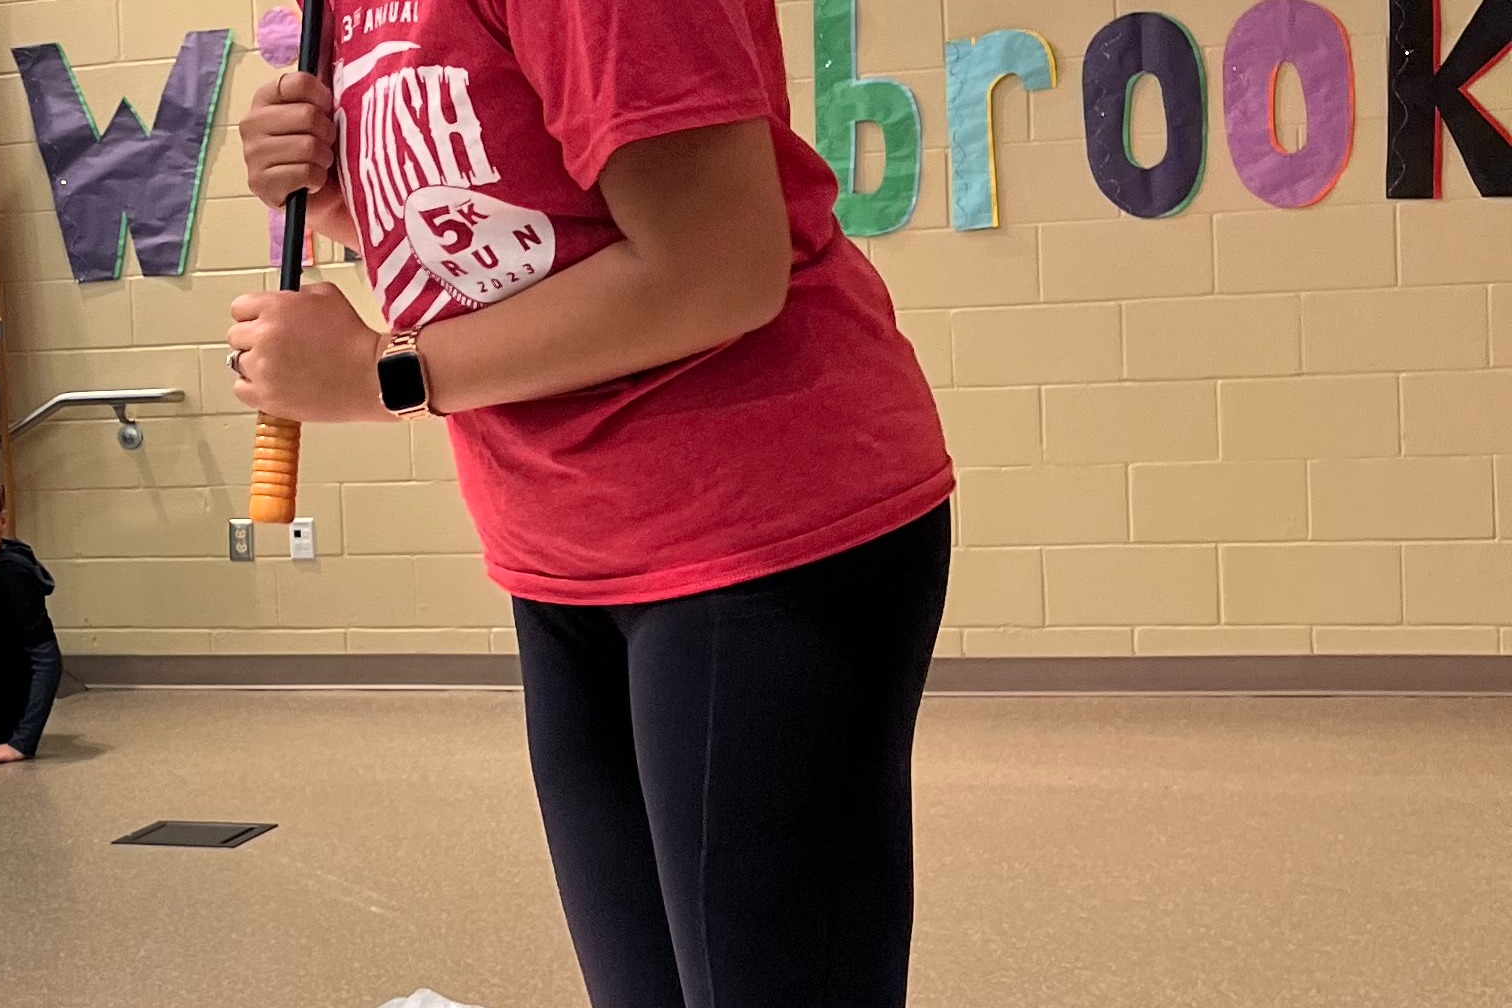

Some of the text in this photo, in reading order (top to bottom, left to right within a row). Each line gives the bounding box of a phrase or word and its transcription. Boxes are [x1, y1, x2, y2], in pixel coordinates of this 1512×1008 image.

[359, 64, 502, 247] RUSH
[418, 199, 490, 255] 5K
[440, 224, 542, 277] RUN
[477, 263, 535, 293] 2023
